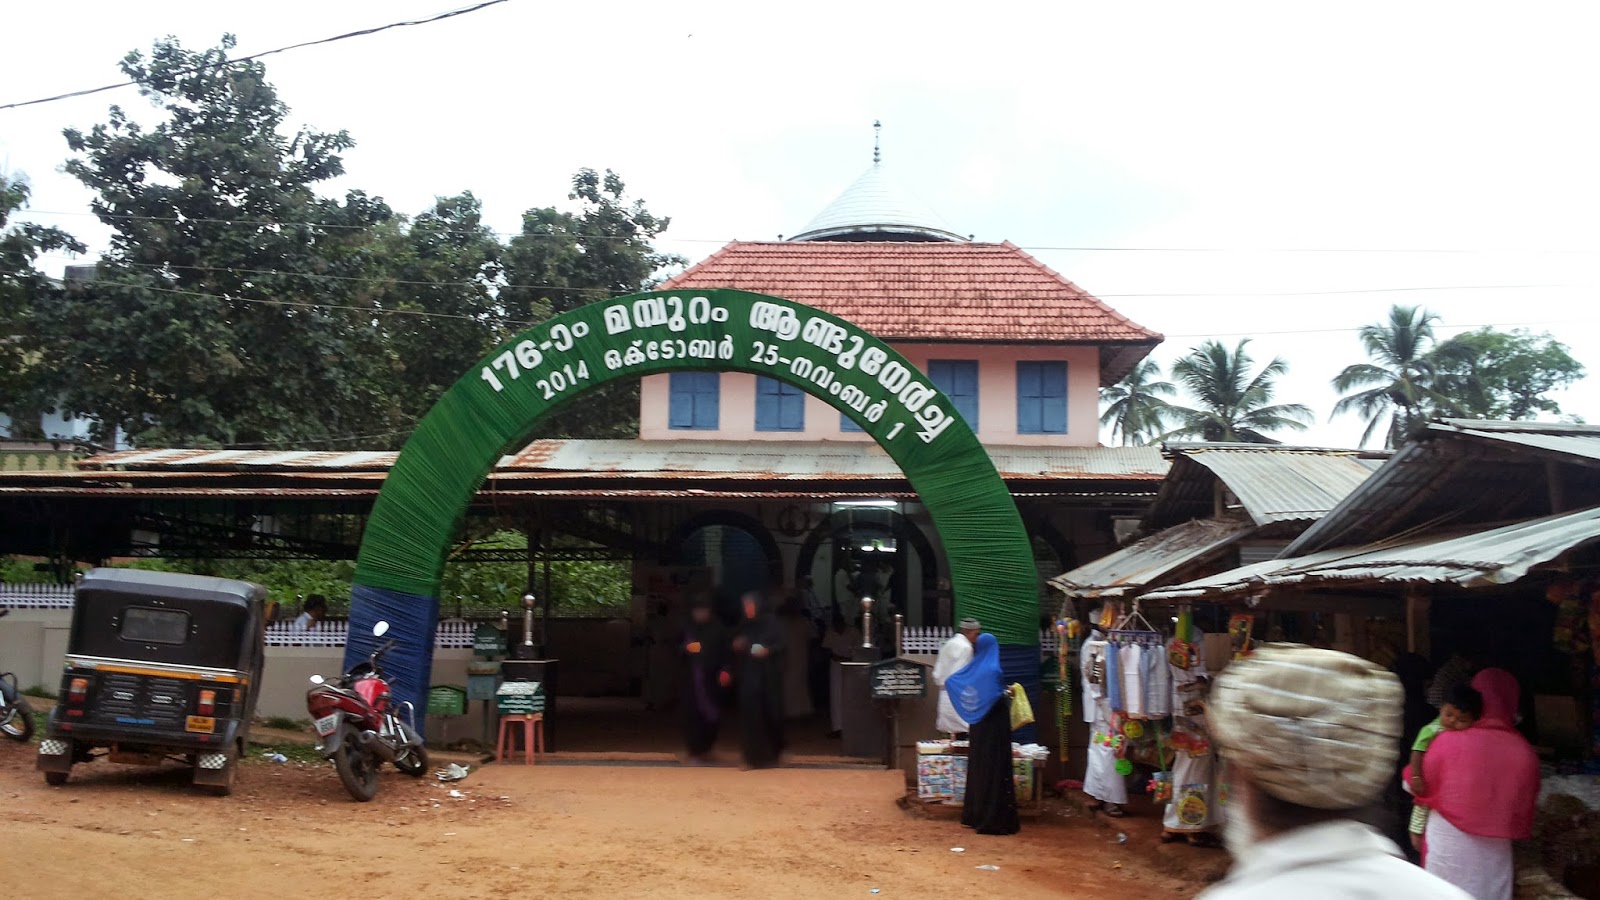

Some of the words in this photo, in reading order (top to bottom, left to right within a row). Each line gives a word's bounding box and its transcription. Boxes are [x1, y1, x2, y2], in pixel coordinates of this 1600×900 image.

[536, 360, 590, 401] 2014
[603, 334, 735, 370] ഒക്ടോബർ
[885, 422, 905, 440] 1
[603, 296, 730, 335] മമ്പുറം
[749, 301, 955, 444] ആണ്ടുനേർച്ച
